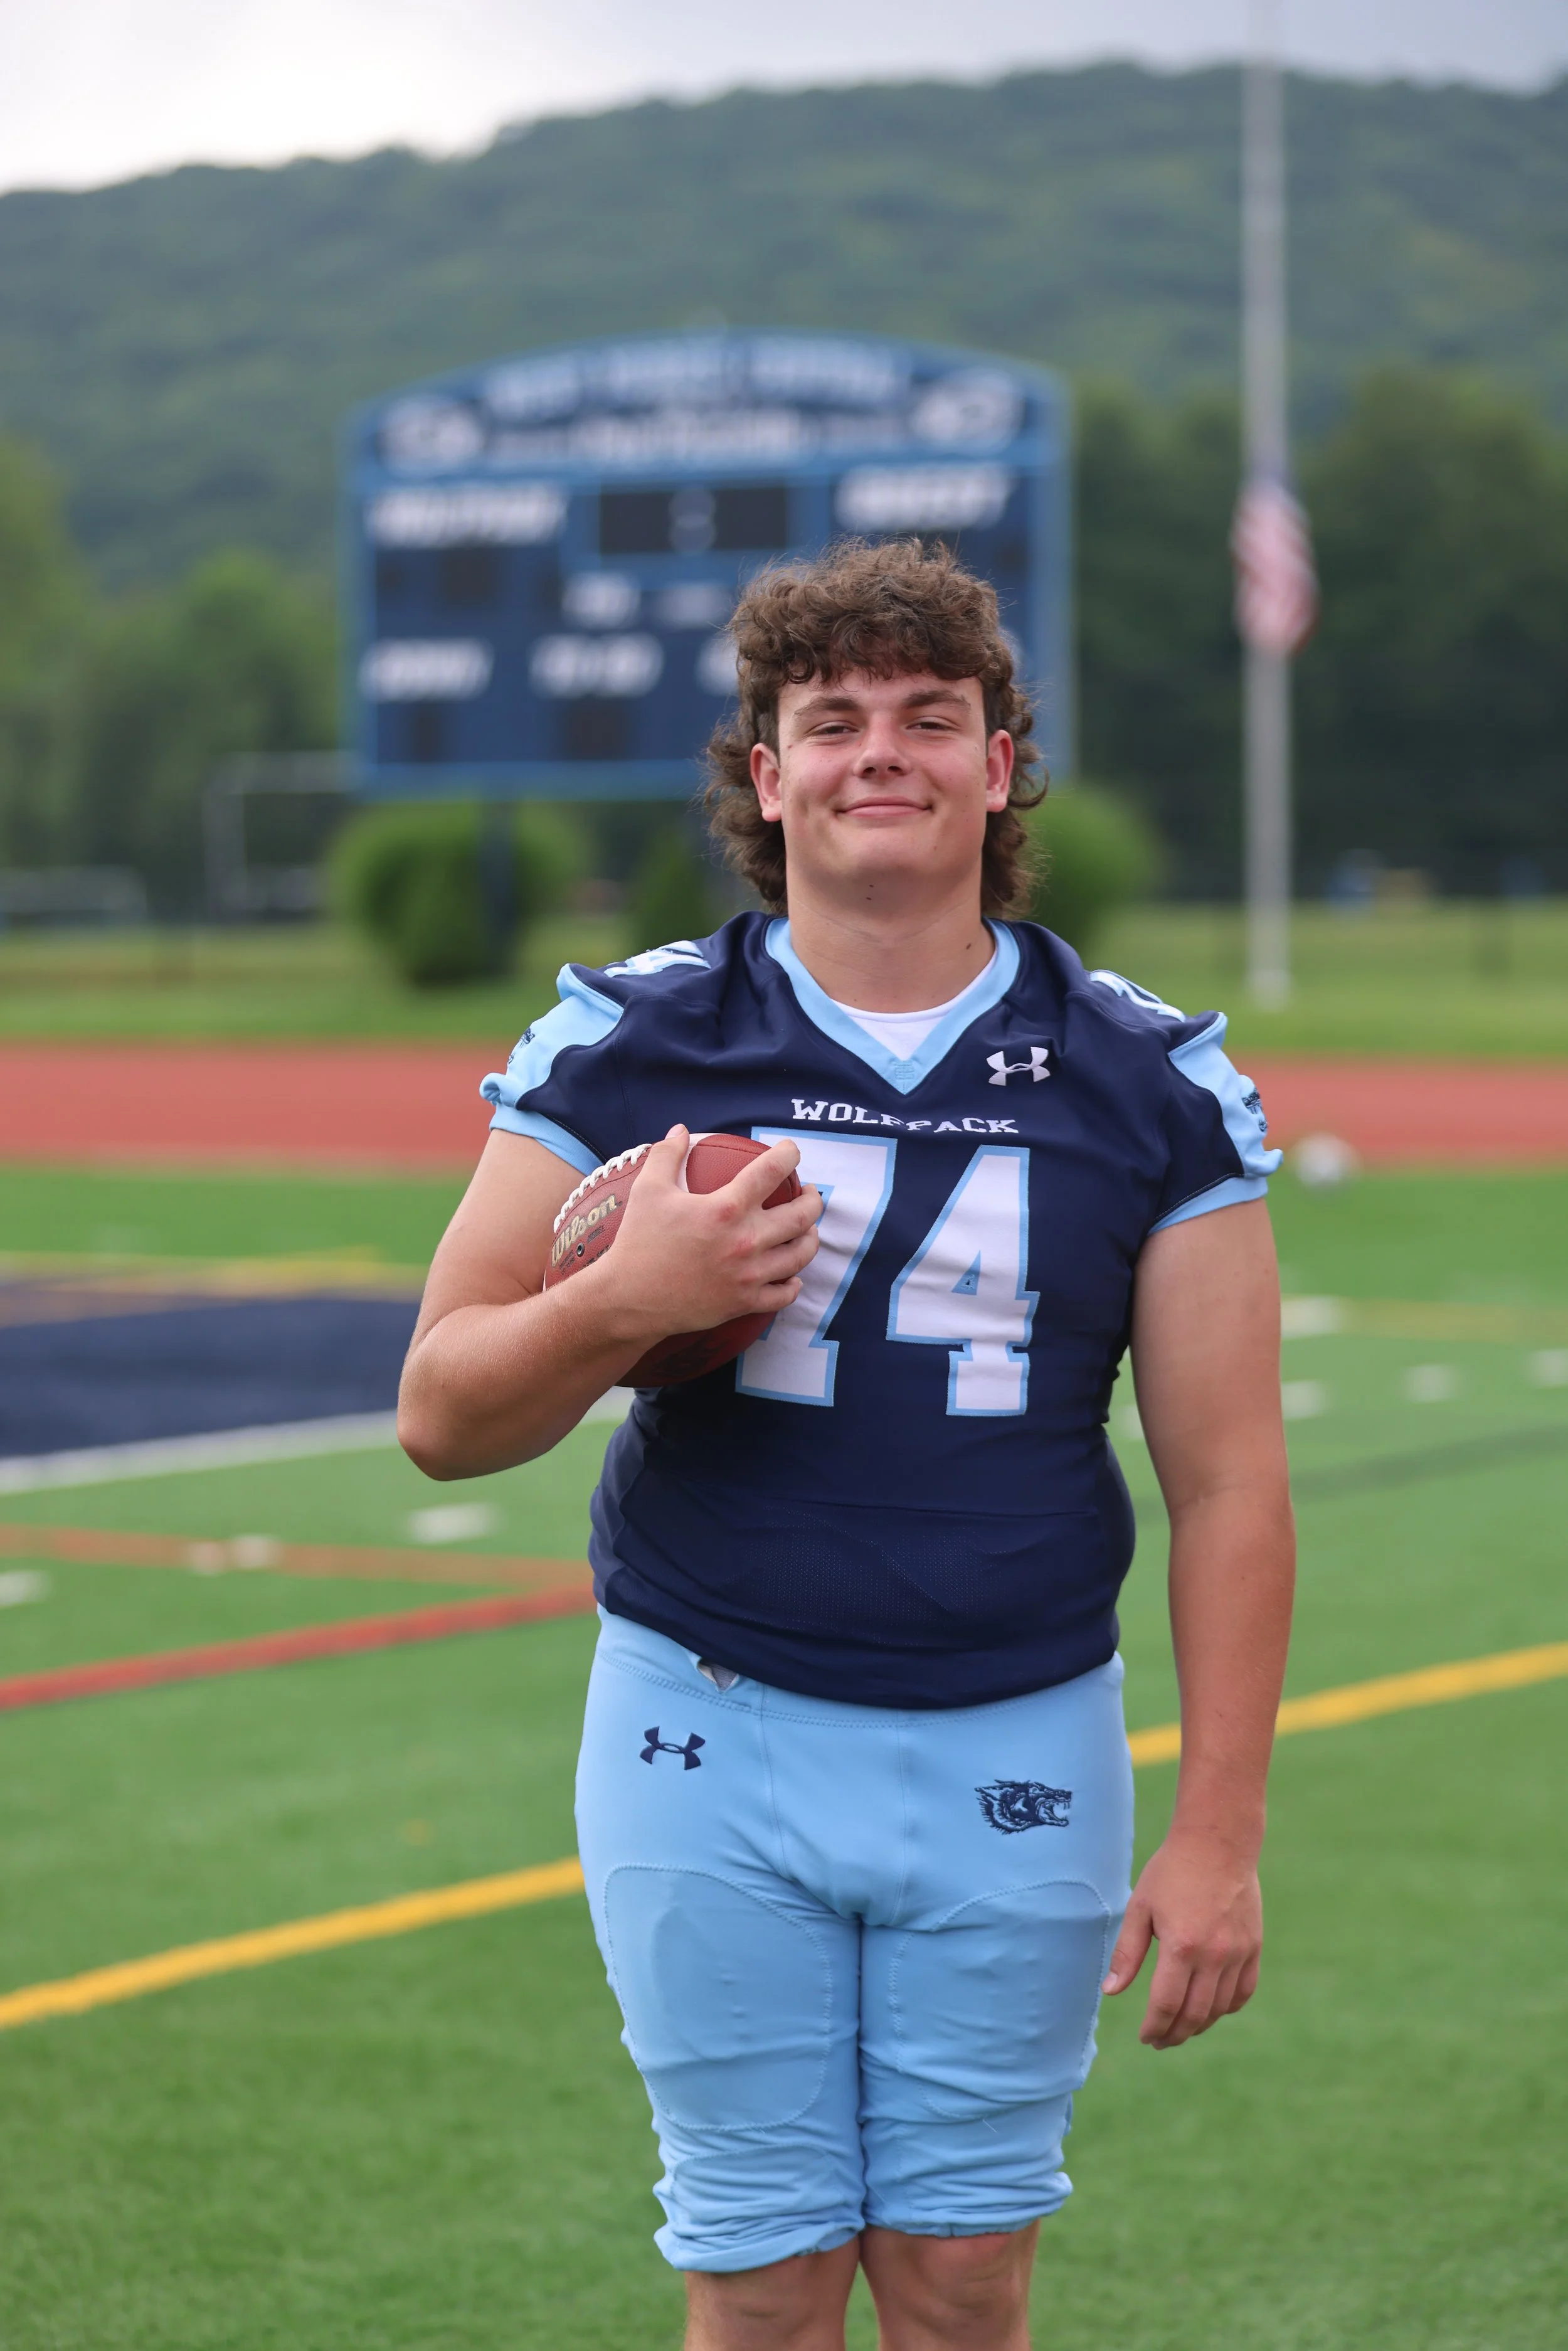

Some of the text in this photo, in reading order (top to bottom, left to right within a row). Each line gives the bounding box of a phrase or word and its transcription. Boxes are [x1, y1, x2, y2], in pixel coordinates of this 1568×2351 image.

[791, 1098, 1019, 1133] WOLFPACK
[551, 1194, 617, 1267] Wilson
[735, 1127, 1041, 1416] 74
